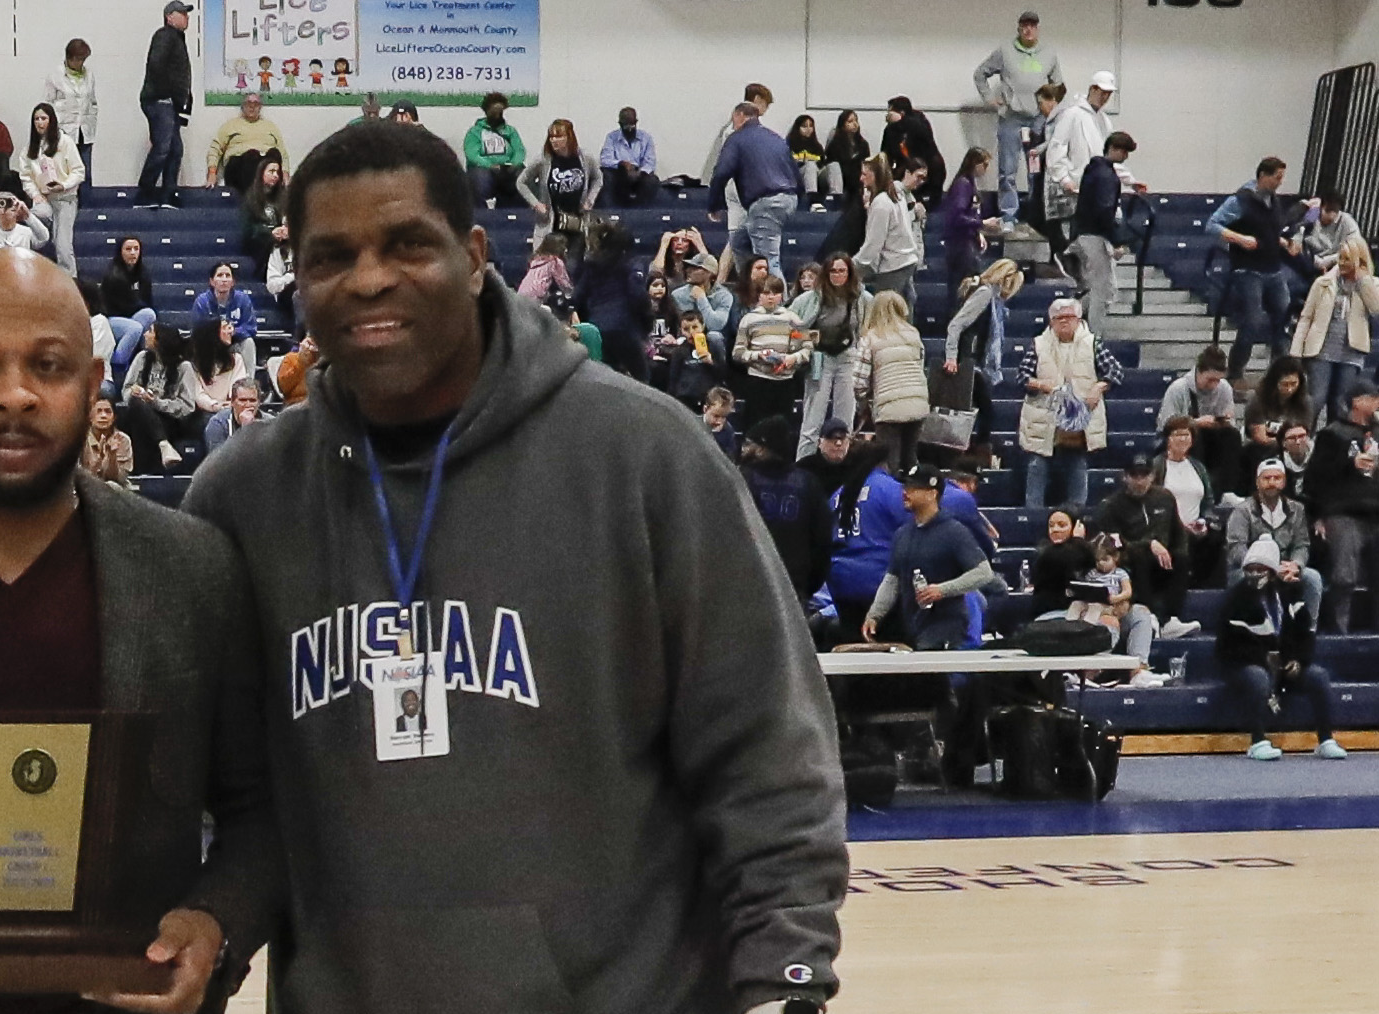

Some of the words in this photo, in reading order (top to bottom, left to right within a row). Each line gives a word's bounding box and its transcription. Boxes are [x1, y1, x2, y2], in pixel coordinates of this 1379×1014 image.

[432, 0, 481, 10] Treatment
[231, 10, 350, 46] Lifters
[382, 25, 414, 35] Ocean
[429, 25, 481, 35] Monmouth
[483, 24, 518, 36] County
[391, 66, 433, 82] (848)
[436, 66, 511, 80] 238-7331
